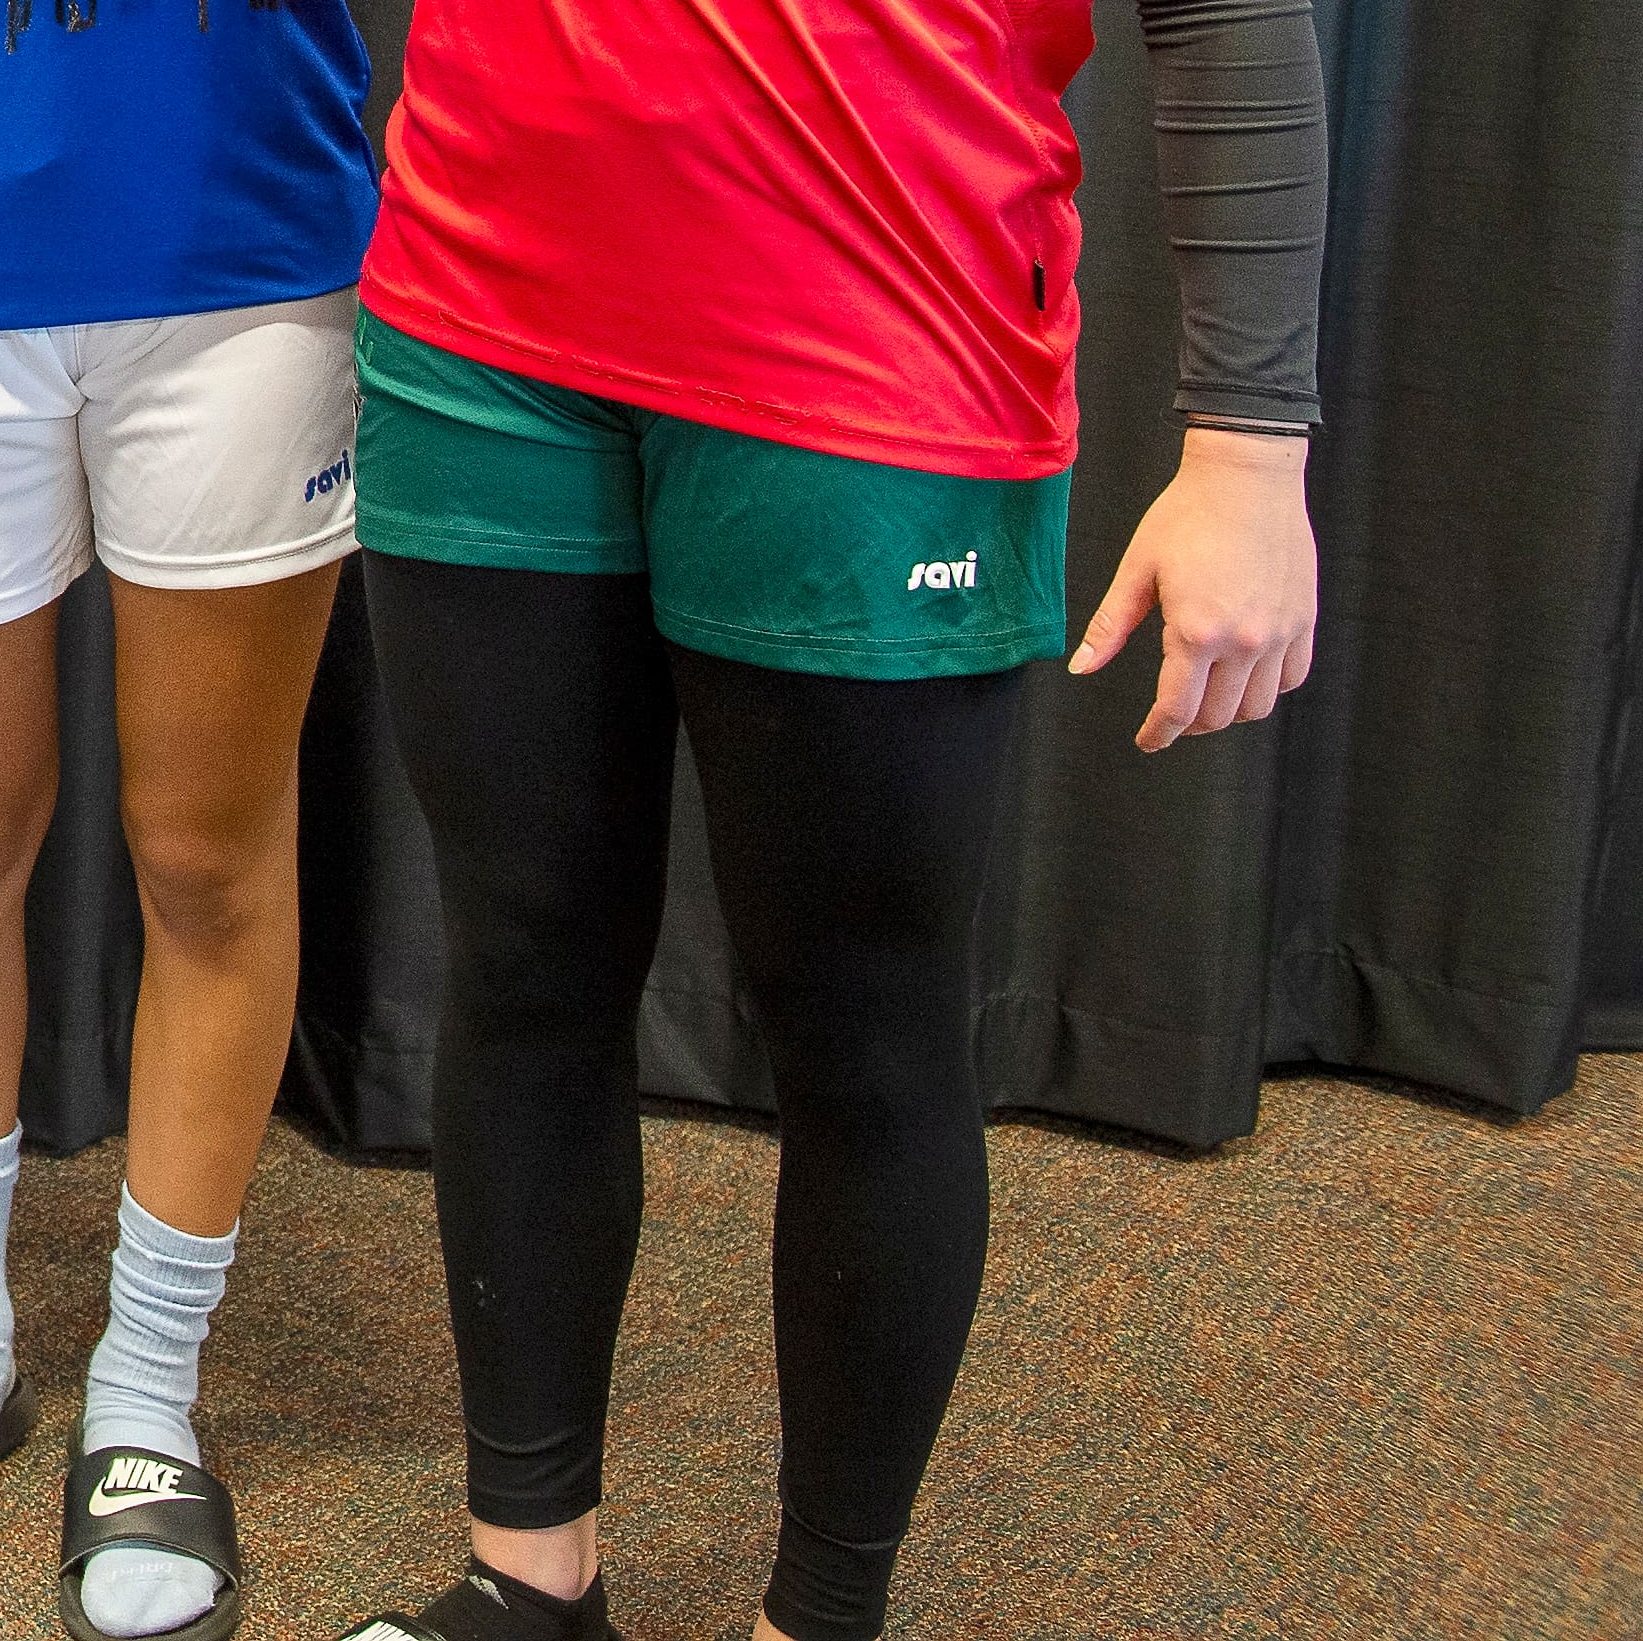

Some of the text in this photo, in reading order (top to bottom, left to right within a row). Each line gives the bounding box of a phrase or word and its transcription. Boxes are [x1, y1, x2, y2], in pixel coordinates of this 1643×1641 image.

[304, 449, 351, 503] savi
[907, 550, 977, 591] savi
[104, 1457, 184, 1494] NIKE
